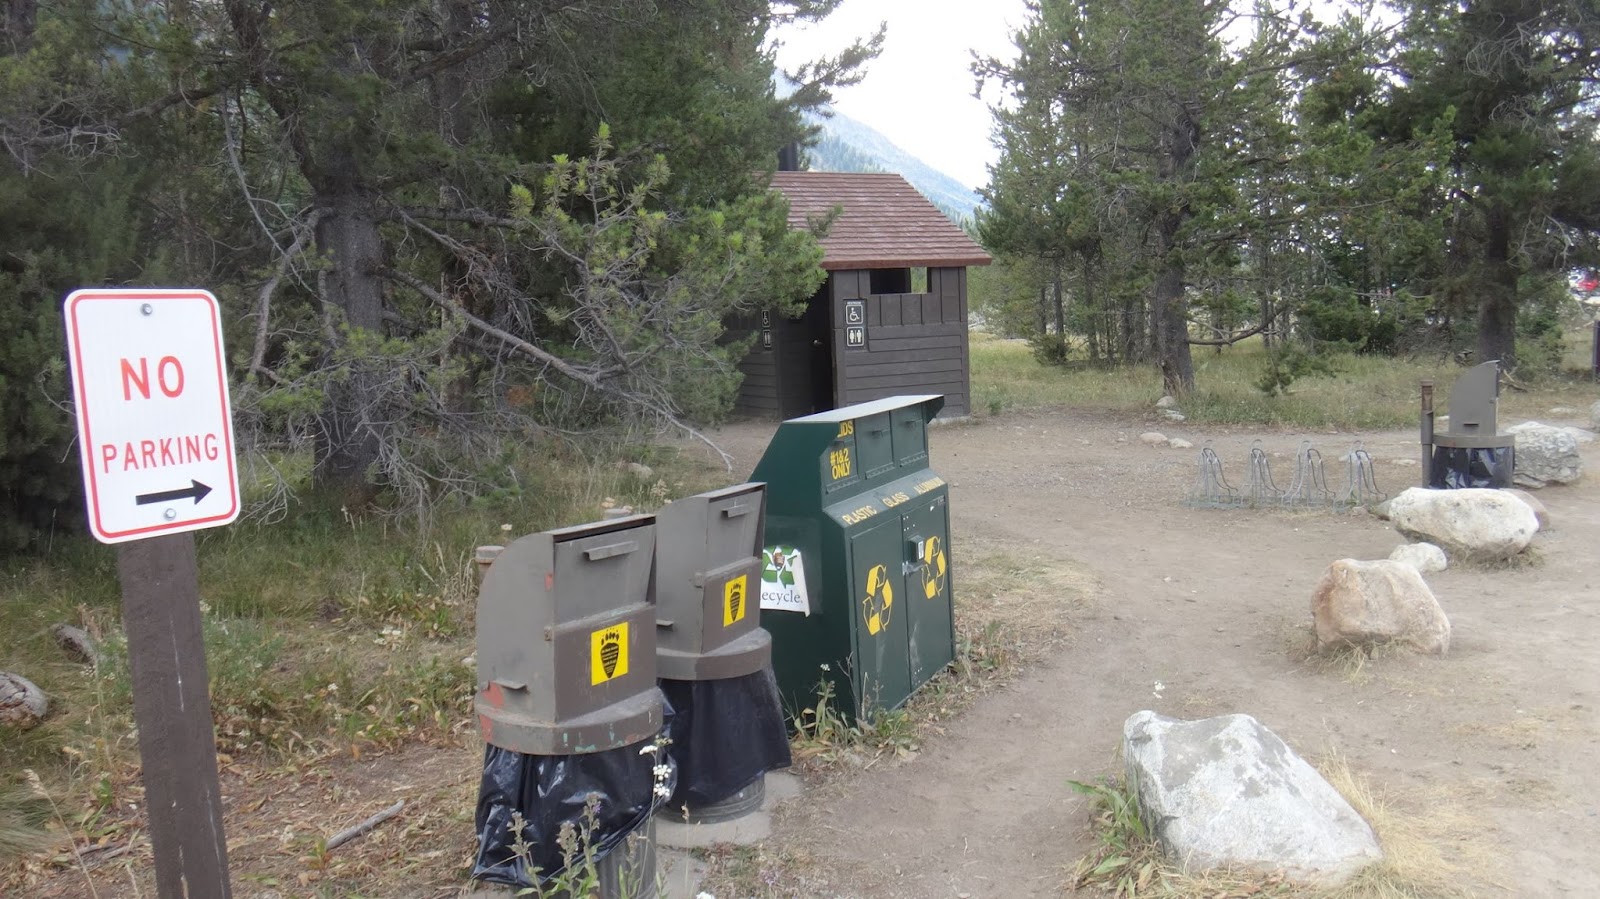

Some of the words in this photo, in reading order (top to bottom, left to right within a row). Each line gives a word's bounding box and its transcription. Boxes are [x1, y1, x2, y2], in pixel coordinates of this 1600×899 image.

[120, 355, 185, 401] NO
[837, 420, 854, 438] IDS
[101, 432, 219, 474] PARKING
[830, 447, 850, 466] #1&2
[831, 461, 851, 480] ONLY
[841, 505, 877, 525] PLASTIC
[882, 491, 910, 508] GLASS
[759, 589, 804, 606] ecycle.
